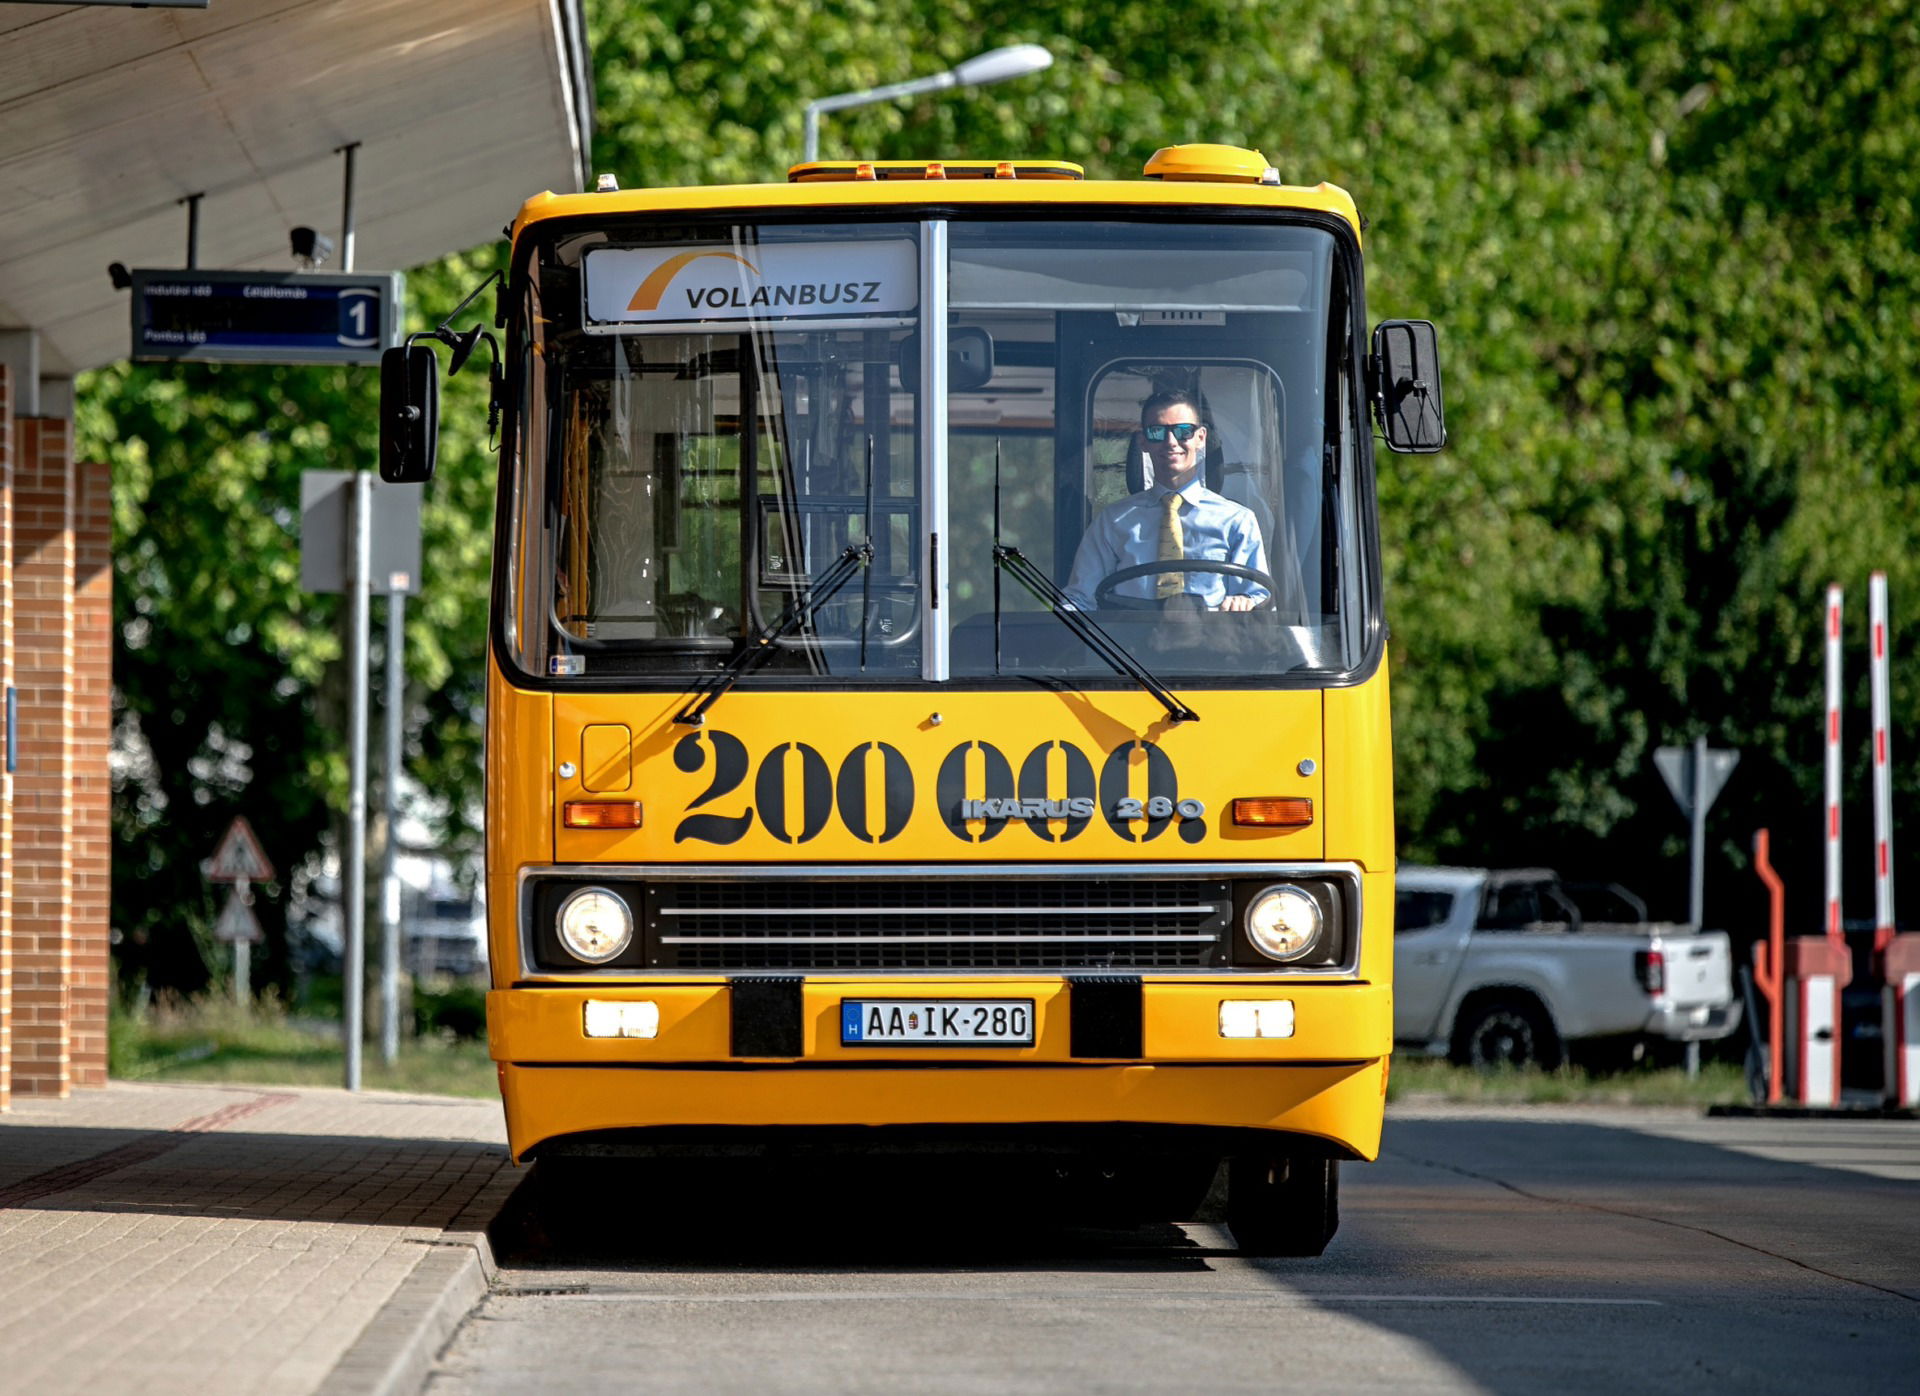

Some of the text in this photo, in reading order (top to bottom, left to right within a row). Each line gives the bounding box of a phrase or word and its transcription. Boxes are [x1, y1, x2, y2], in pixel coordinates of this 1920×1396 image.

[349, 300, 367, 336] 1
[673, 729, 916, 845] 200
[961, 796, 1206, 820] IKARUS 280
[848, 1023, 858, 1035] H
